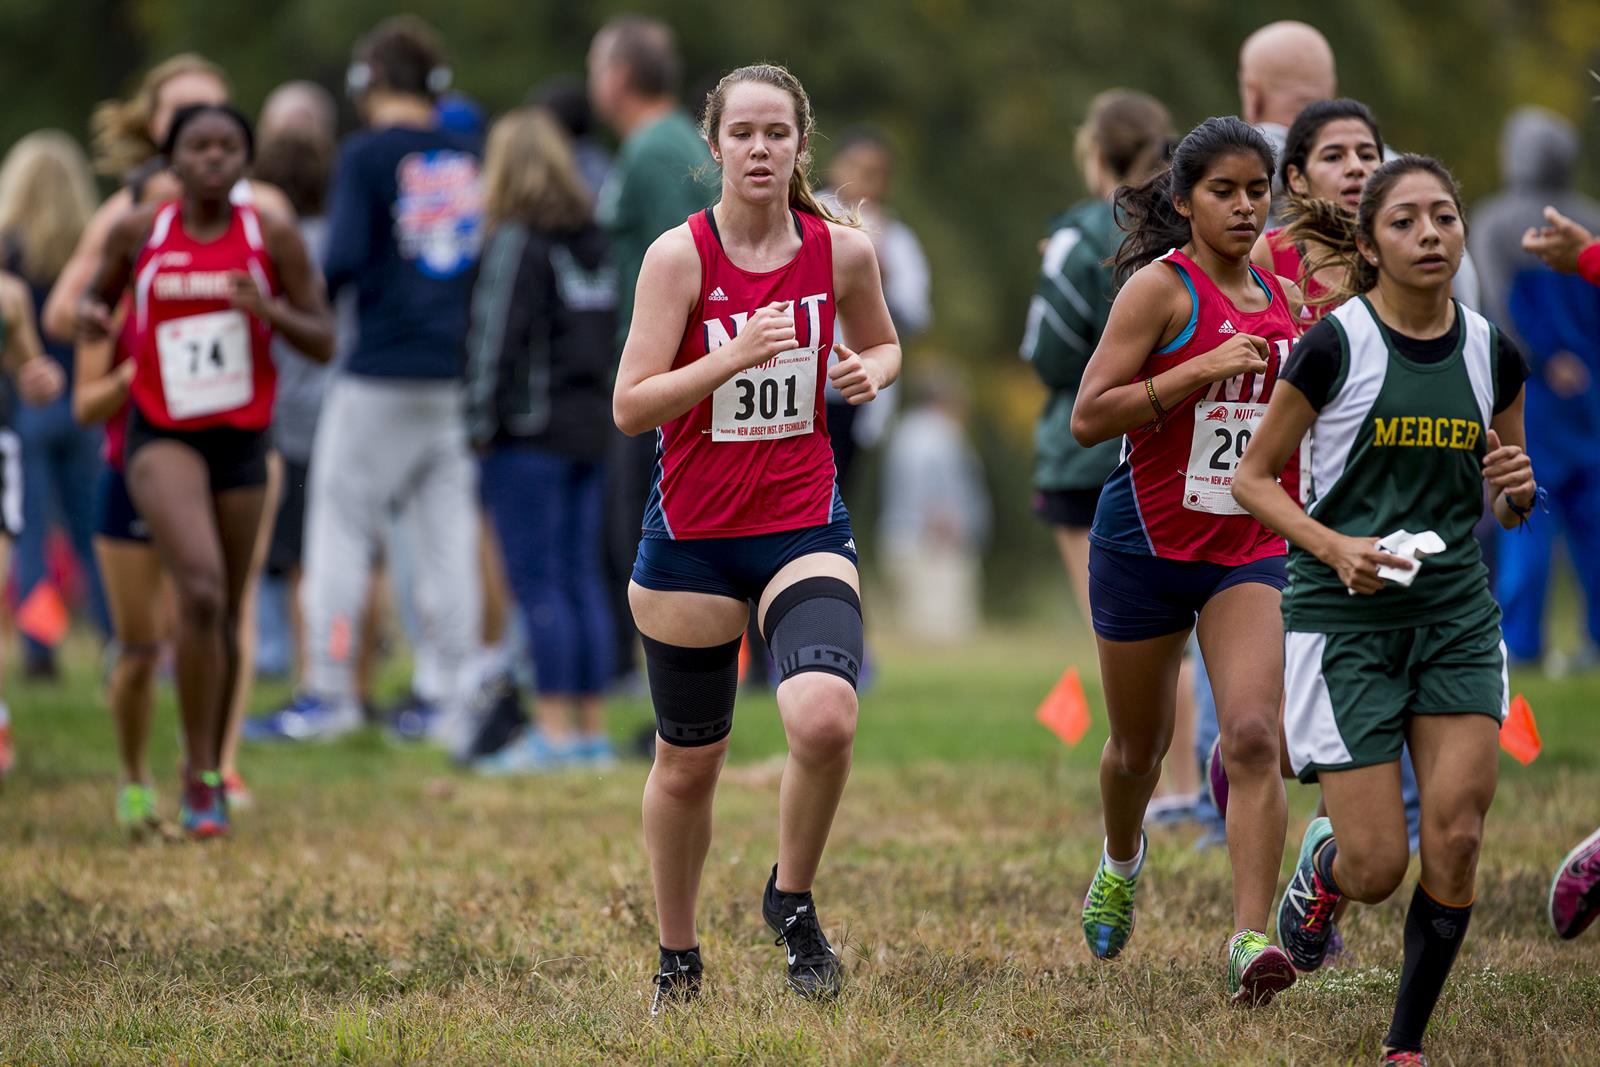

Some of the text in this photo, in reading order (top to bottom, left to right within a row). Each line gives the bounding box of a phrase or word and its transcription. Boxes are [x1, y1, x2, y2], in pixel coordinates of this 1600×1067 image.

[184, 337, 225, 374] 74
[734, 375, 798, 421] 301
[737, 426, 748, 436] NEW
[749, 425, 766, 436] JERSEY
[778, 423, 784, 434] OF
[784, 419, 808, 432] TECHNOLOGY
[1233, 408, 1256, 422] NJIT
[1373, 416, 1480, 450] MERCER
[1210, 475, 1222, 486] NEW
